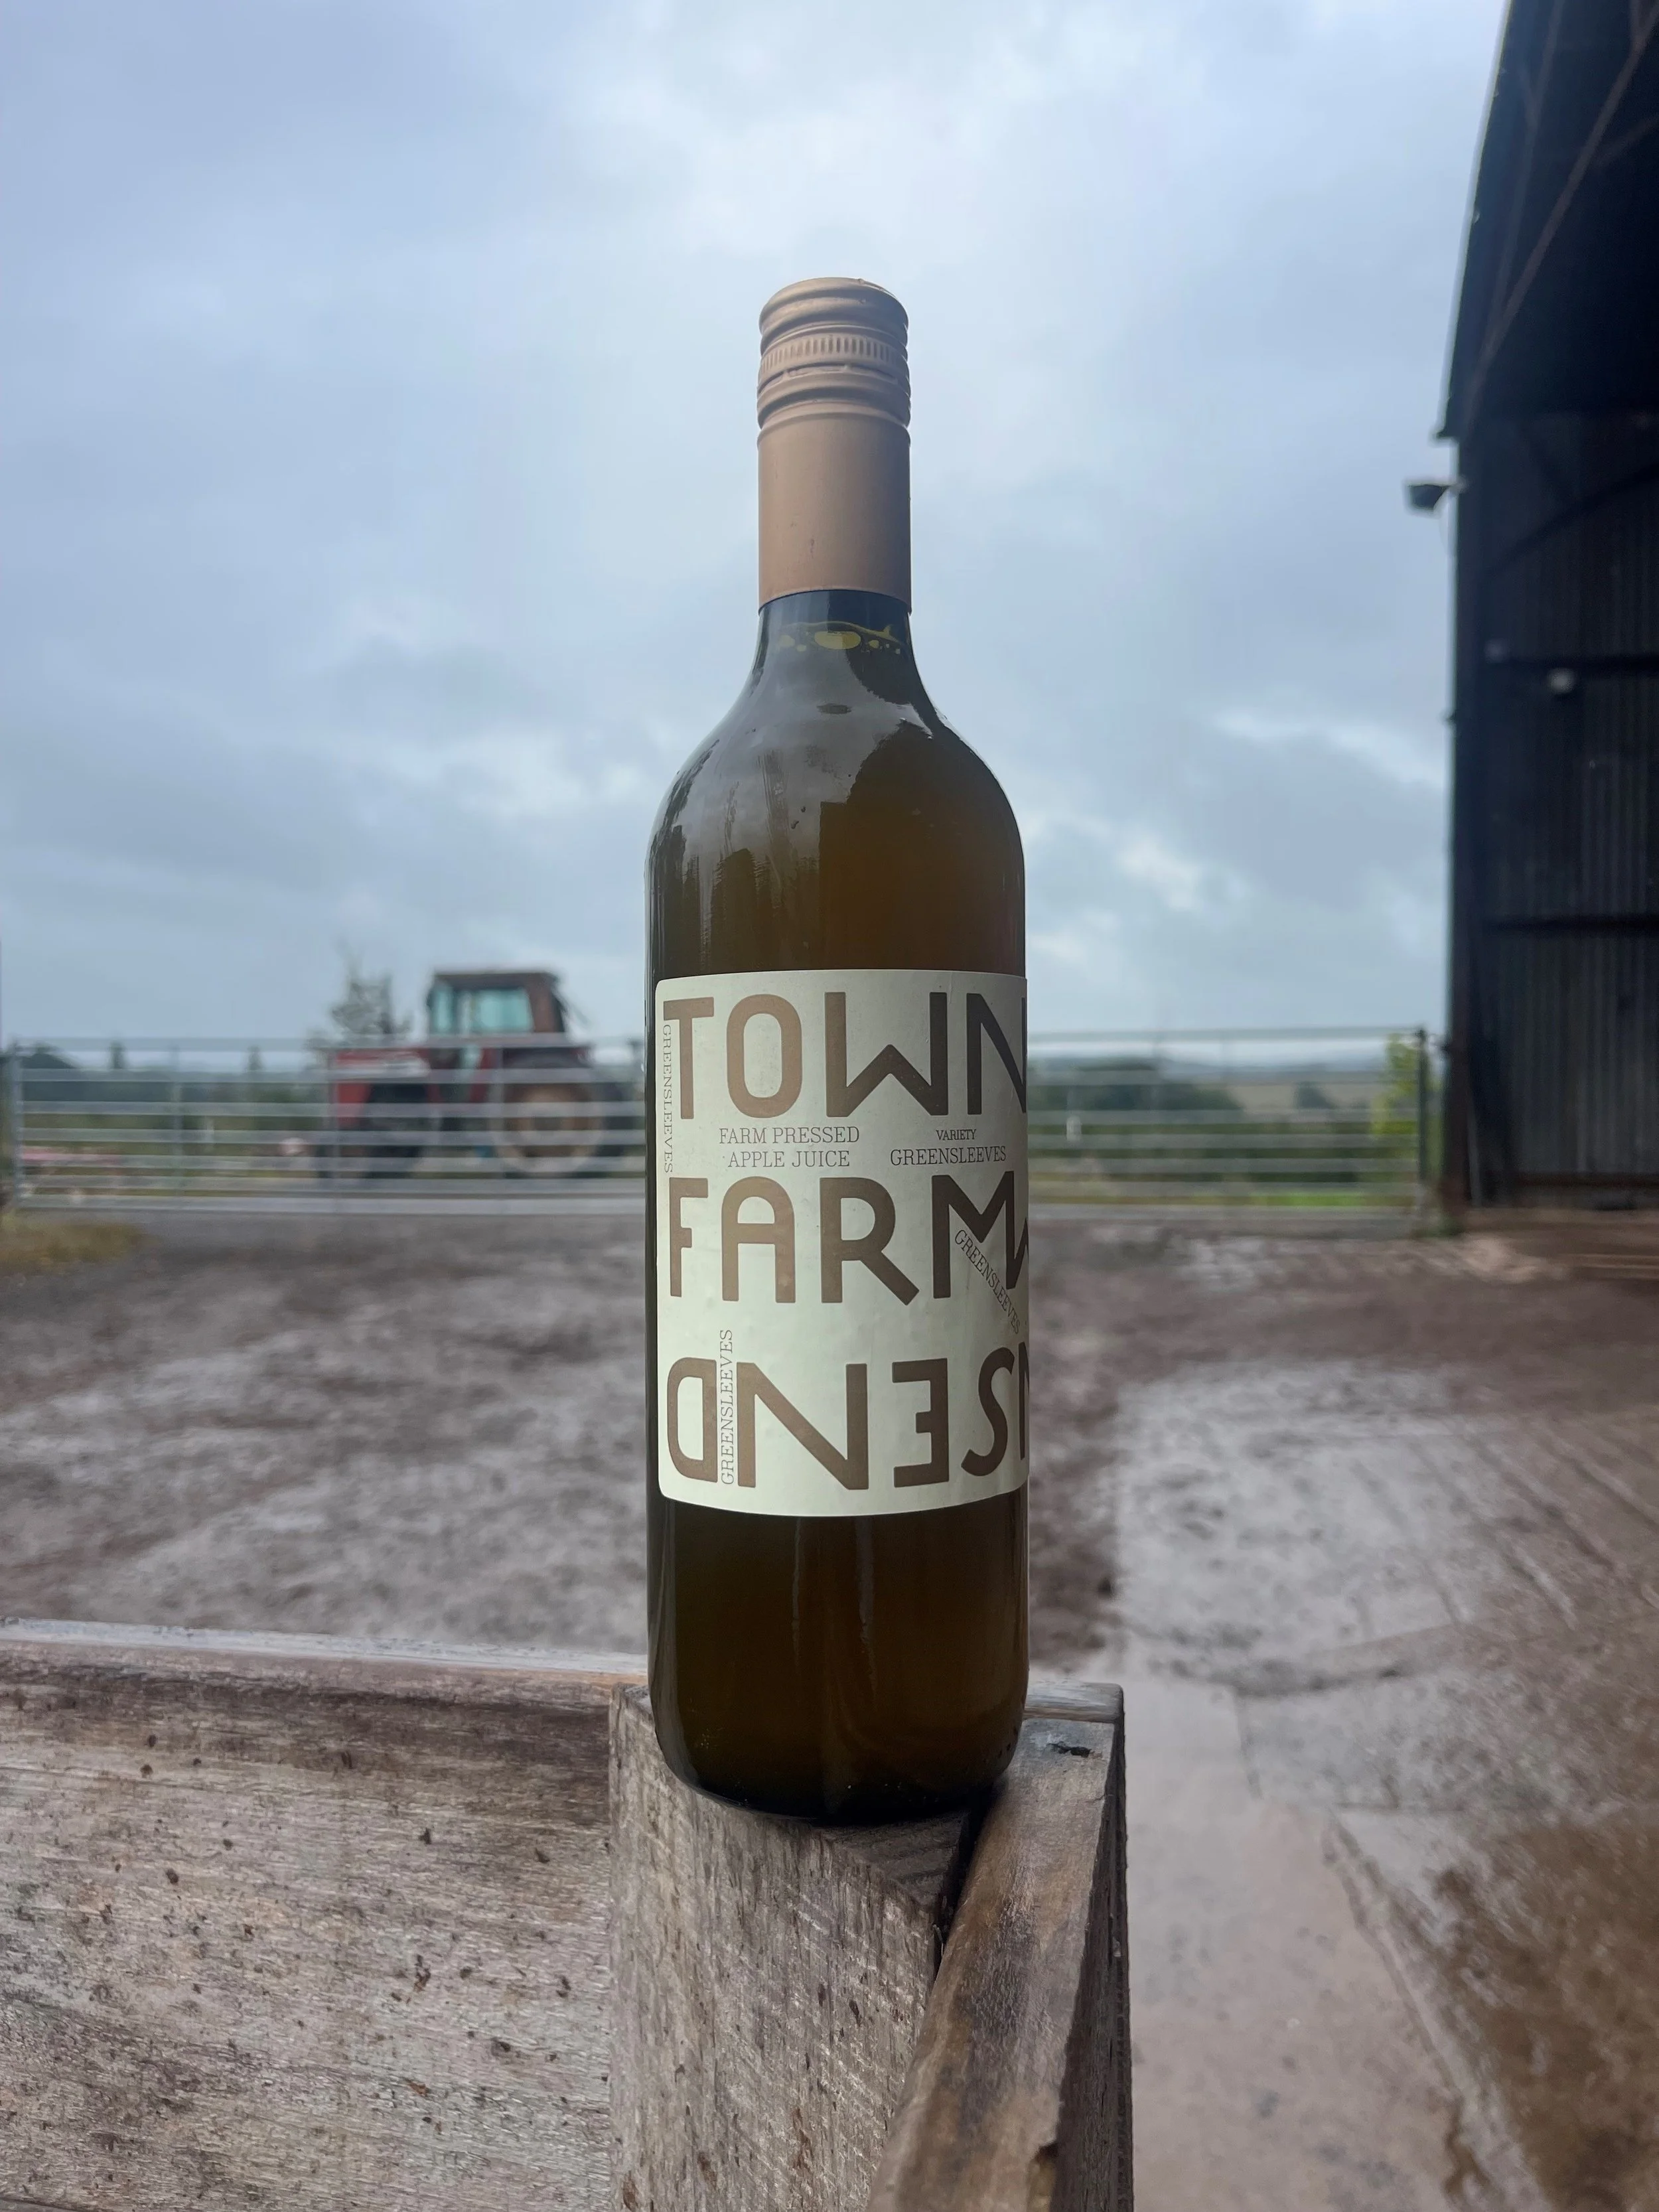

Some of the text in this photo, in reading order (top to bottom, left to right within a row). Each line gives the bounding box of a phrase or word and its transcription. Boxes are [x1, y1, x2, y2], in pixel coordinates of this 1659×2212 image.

[663, 992, 1027, 1120] TOWN
[663, 1023, 674, 1174] GREENSLEEVES
[719, 1126, 860, 1144] FARM PRESSED
[727, 1149, 850, 1168] APPLE JUICE
[890, 1145, 1007, 1166] GREENSLEEVES
[936, 1128, 977, 1141] VARIETY
[954, 1229, 1021, 1335] GREENSLEEVES
[719, 1329, 735, 1485] GREENSLEEVES
